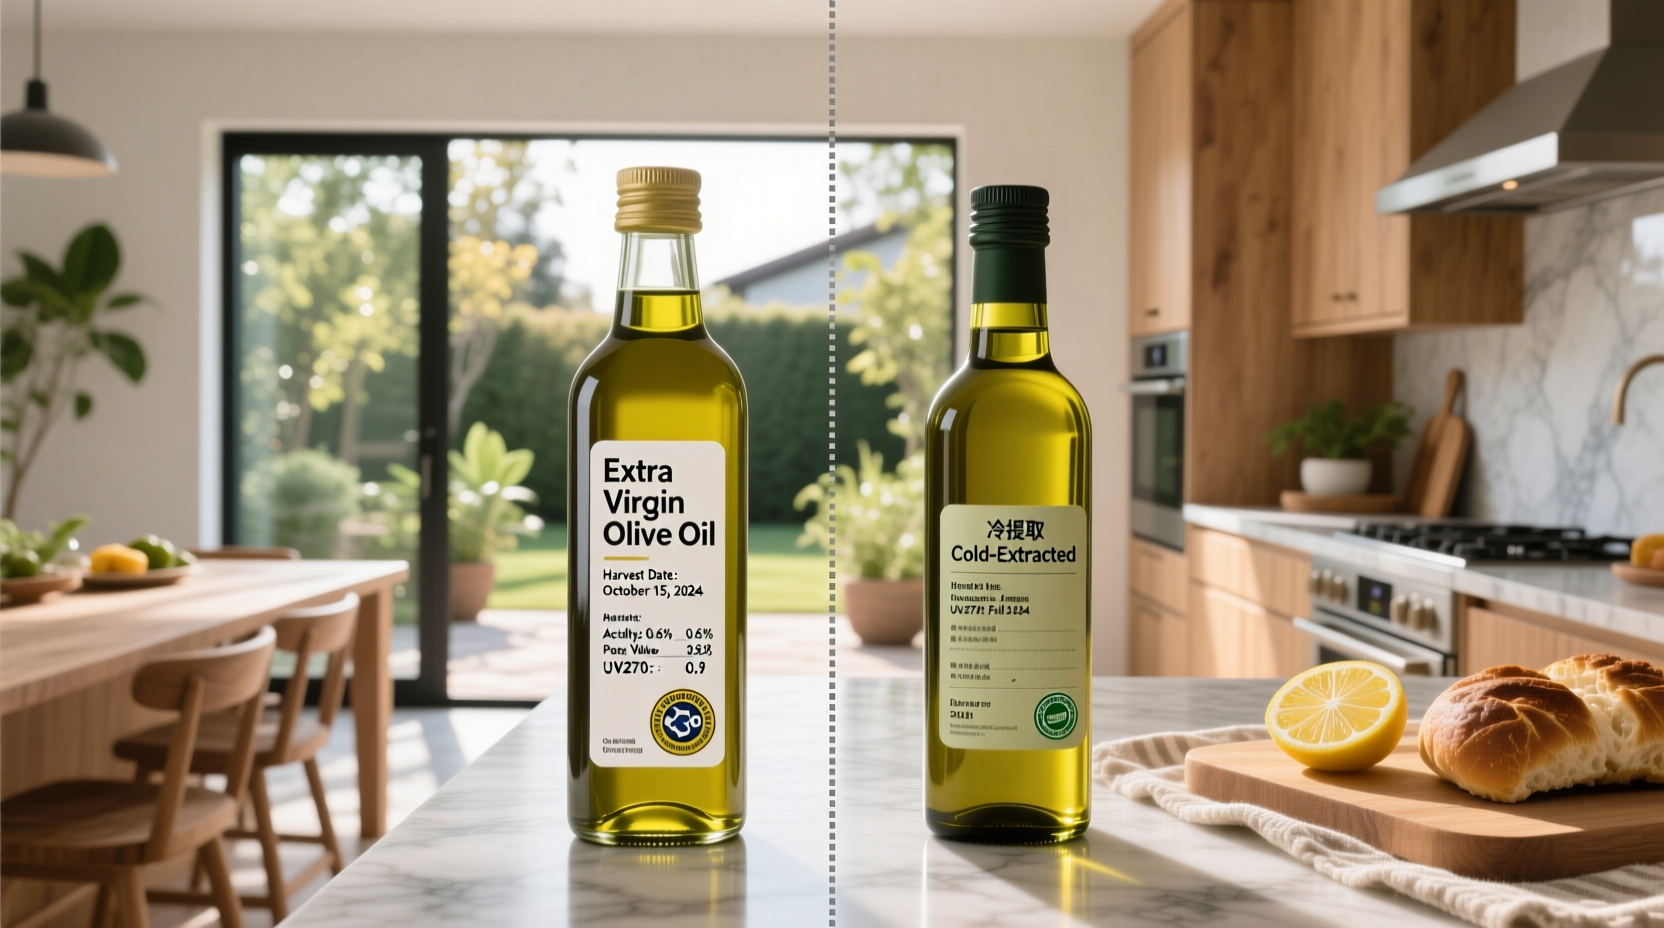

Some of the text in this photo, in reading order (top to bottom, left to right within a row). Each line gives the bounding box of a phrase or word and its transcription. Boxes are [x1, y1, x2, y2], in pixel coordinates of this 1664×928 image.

[604, 457, 673, 483] Extra
[603, 488, 685, 521] Virgin
[603, 520, 715, 546] Olive Oil
[987, 519, 1045, 541] 冷提取
[951, 544, 1076, 563] Cold-Extracted
[603, 568, 678, 580] Harvest Date:
[602, 584, 704, 599] October 15, 2024
[685, 661, 706, 674] 0.9
